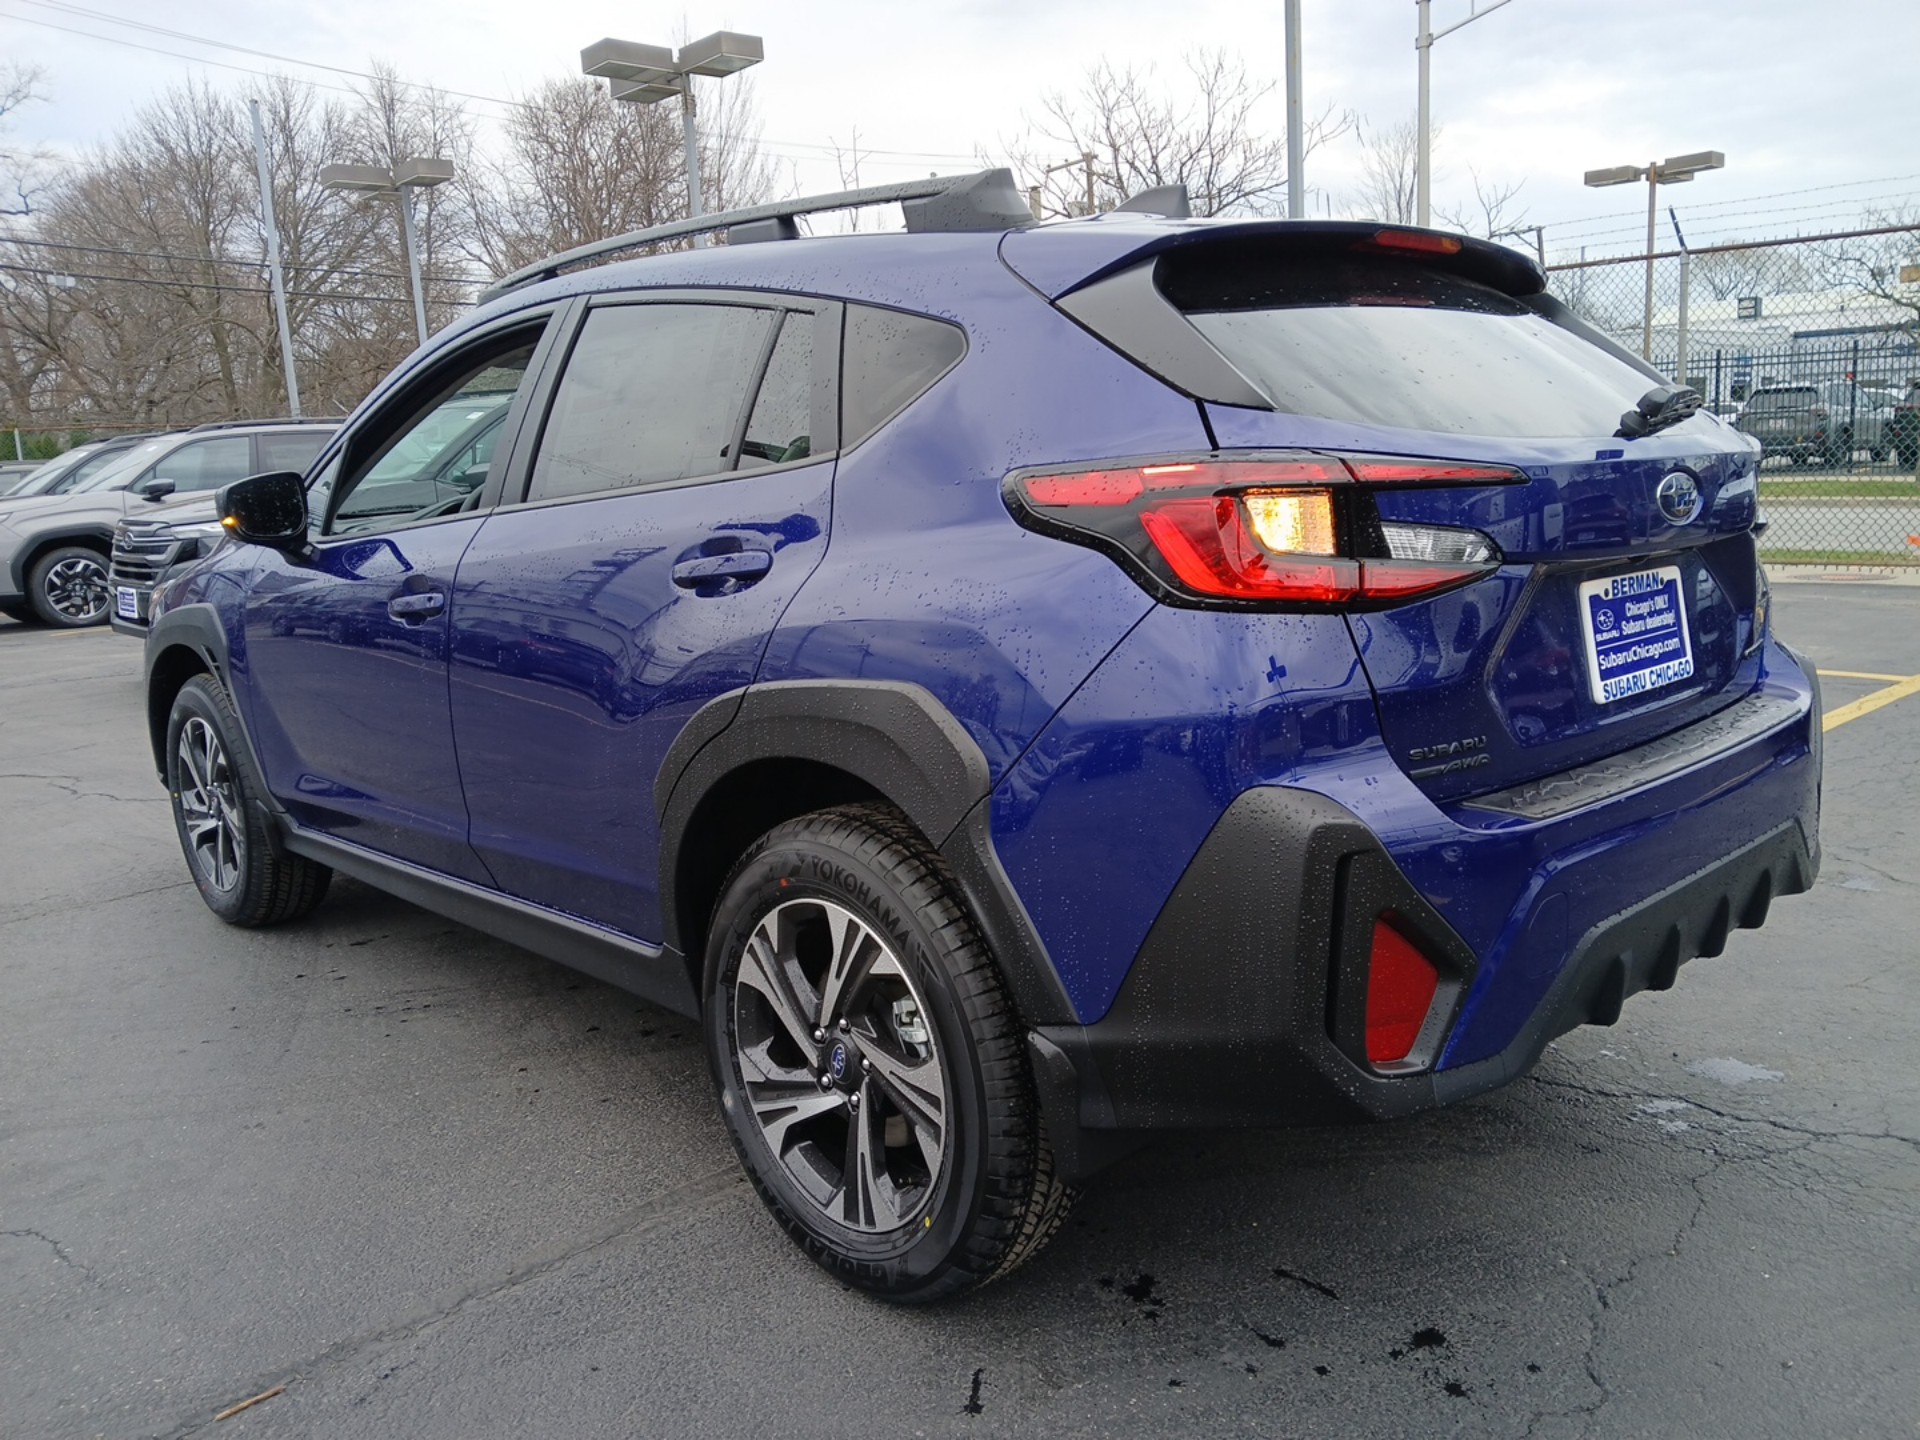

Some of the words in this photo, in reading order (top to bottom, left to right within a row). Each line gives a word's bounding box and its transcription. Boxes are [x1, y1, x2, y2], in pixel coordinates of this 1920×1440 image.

[1611, 571, 1660, 597] BERMAN
[1596, 629, 1620, 642] SUBARU
[1621, 618, 1645, 636] Subaru
[1599, 637, 1681, 670] SubaruChicago.com
[1603, 674, 1647, 700] SUBARU
[1649, 659, 1691, 688] CHICAGO
[1408, 735, 1487, 760] SUBARU
[1442, 753, 1491, 774] AWD
[811, 854, 913, 951] YOKOHAMA
